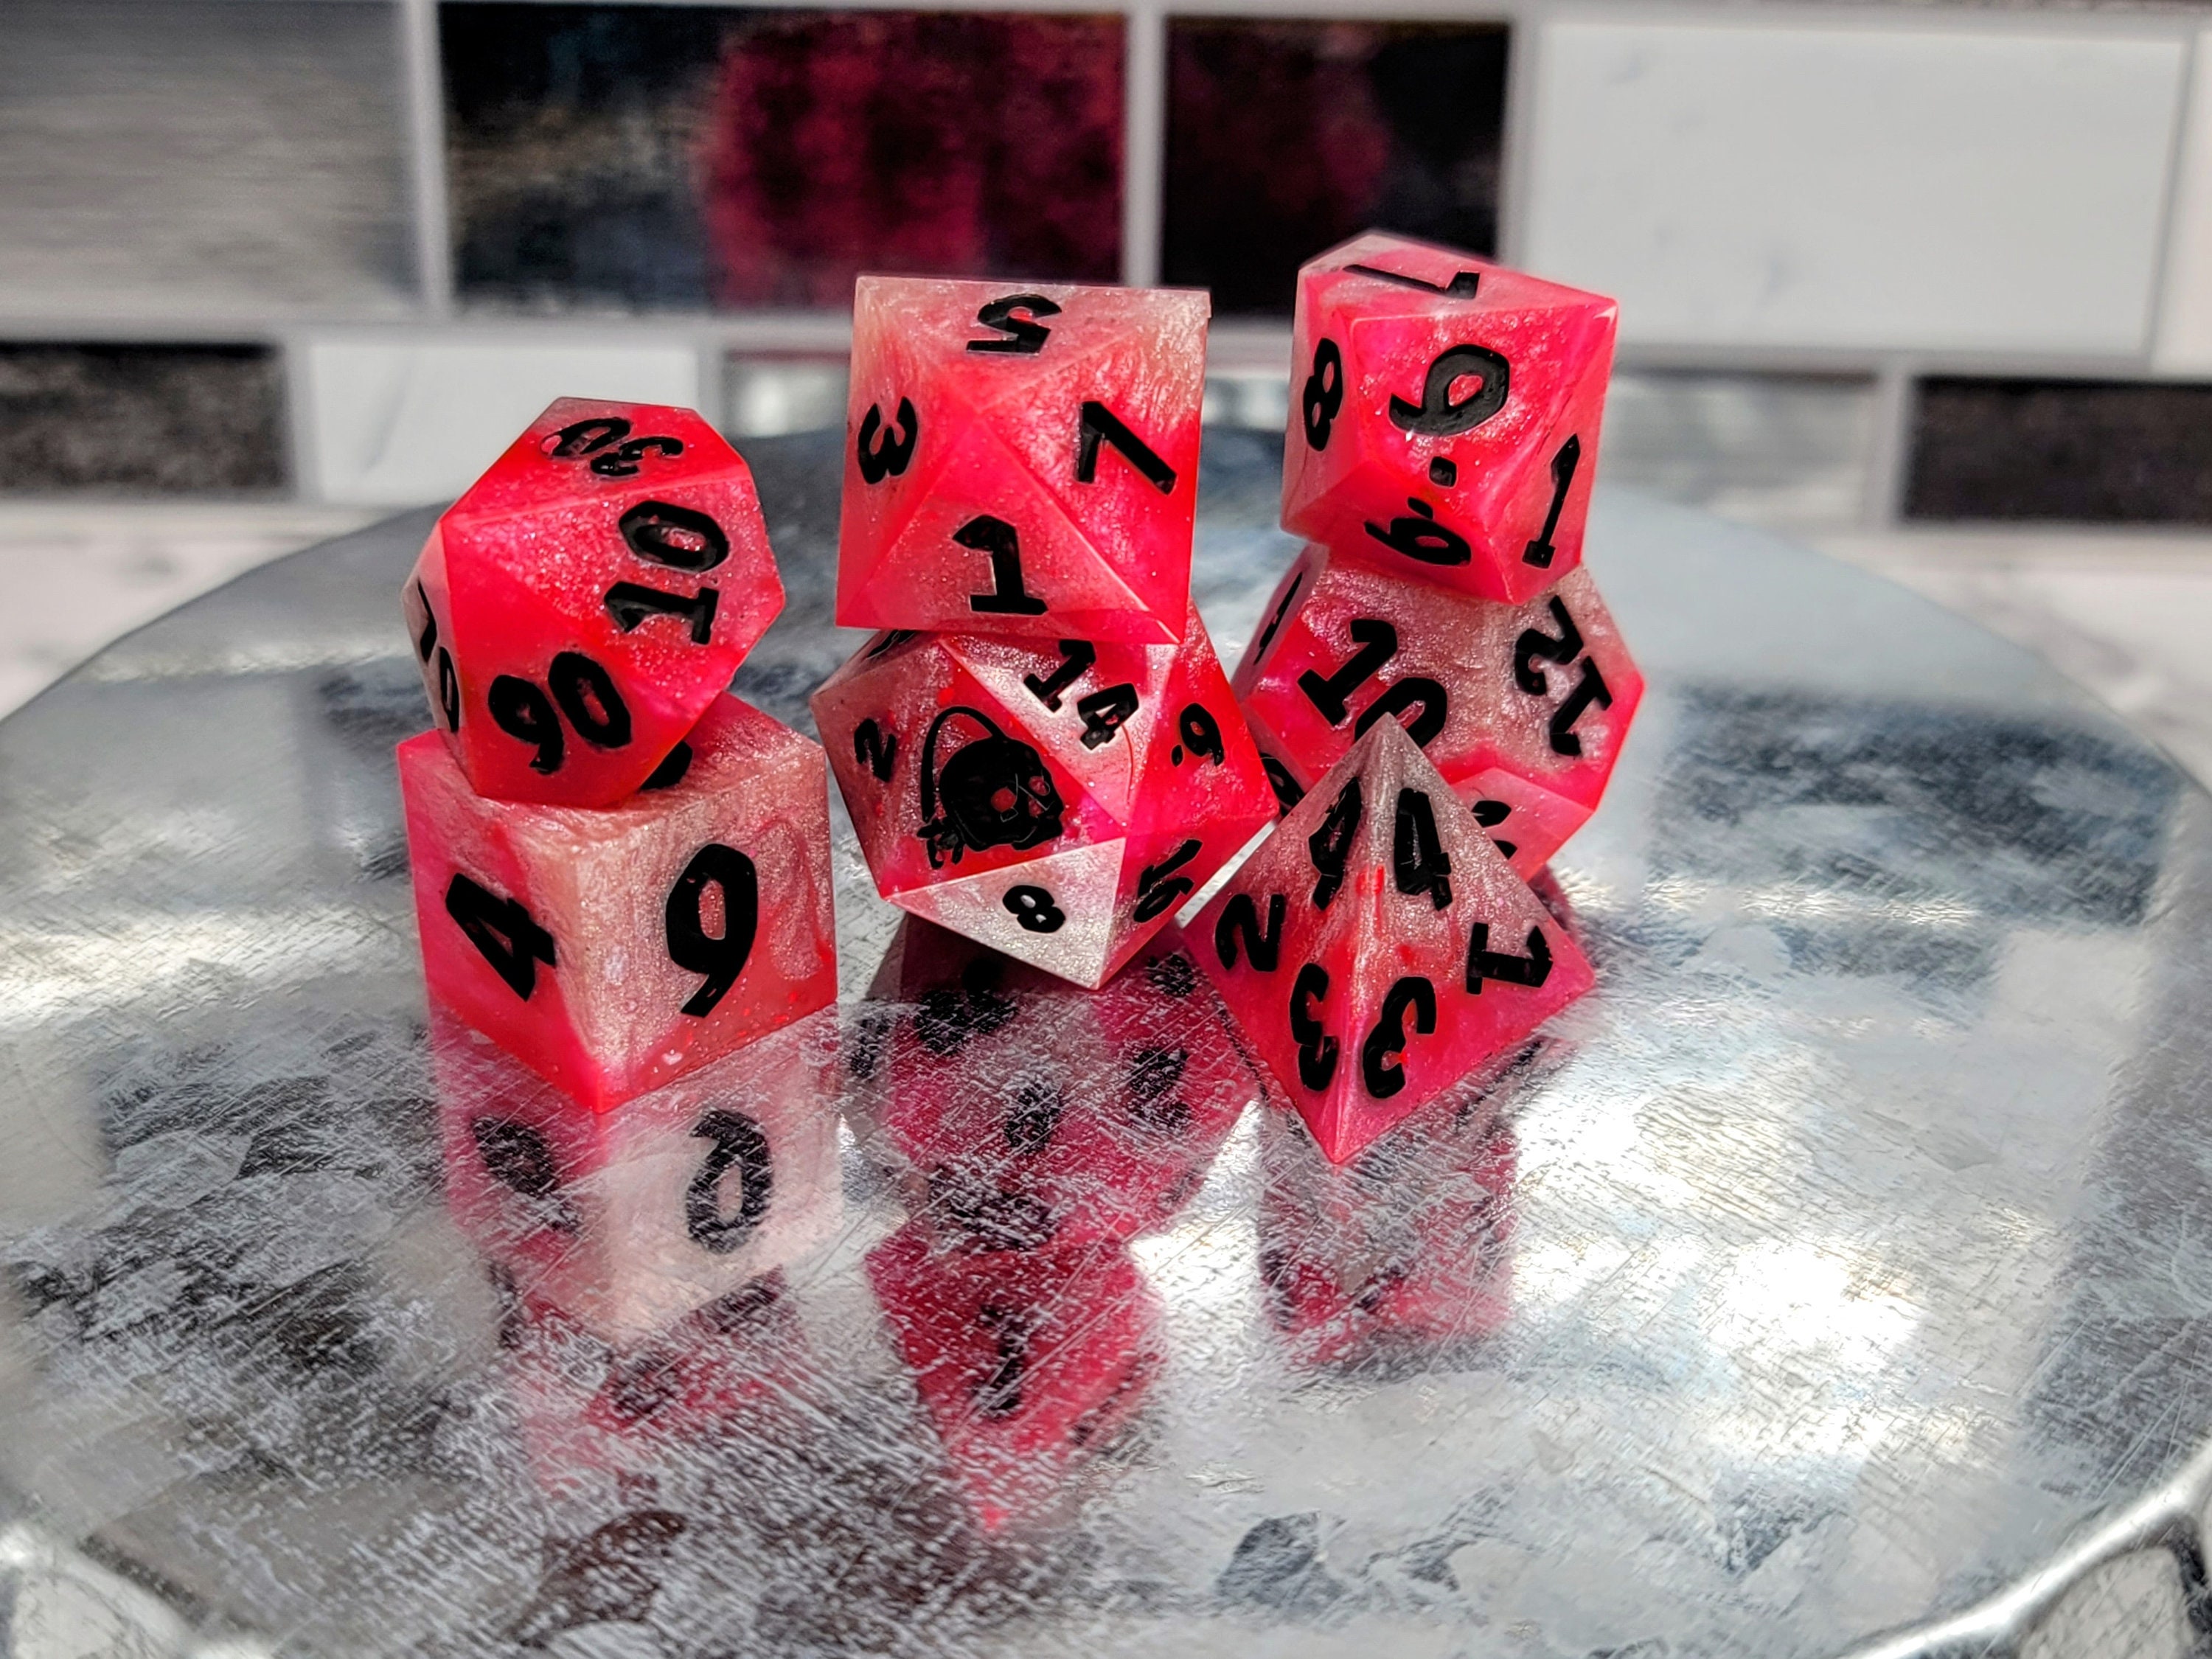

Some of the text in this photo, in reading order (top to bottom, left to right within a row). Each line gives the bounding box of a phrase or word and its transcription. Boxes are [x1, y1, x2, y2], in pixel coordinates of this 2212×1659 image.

[858, 397, 918, 485] 3
[1303, 338, 1343, 452] 8
[1523, 434, 1581, 568] 1
[604, 500, 730, 646] 10
[952, 515, 1048, 616] 1
[487, 651, 633, 776] 90
[1023, 639, 1139, 751] 14
[1297, 618, 1448, 750] 10
[853, 716, 904, 785] 2
[1002, 884, 1066, 933] 8
[1392, 786, 1453, 912] 4
[445, 872, 557, 1002] 4
[1214, 892, 1288, 973] 2
[1465, 922, 1554, 995] 1
[1289, 962, 1340, 1093] 3
[1361, 976, 1437, 1100] 3
